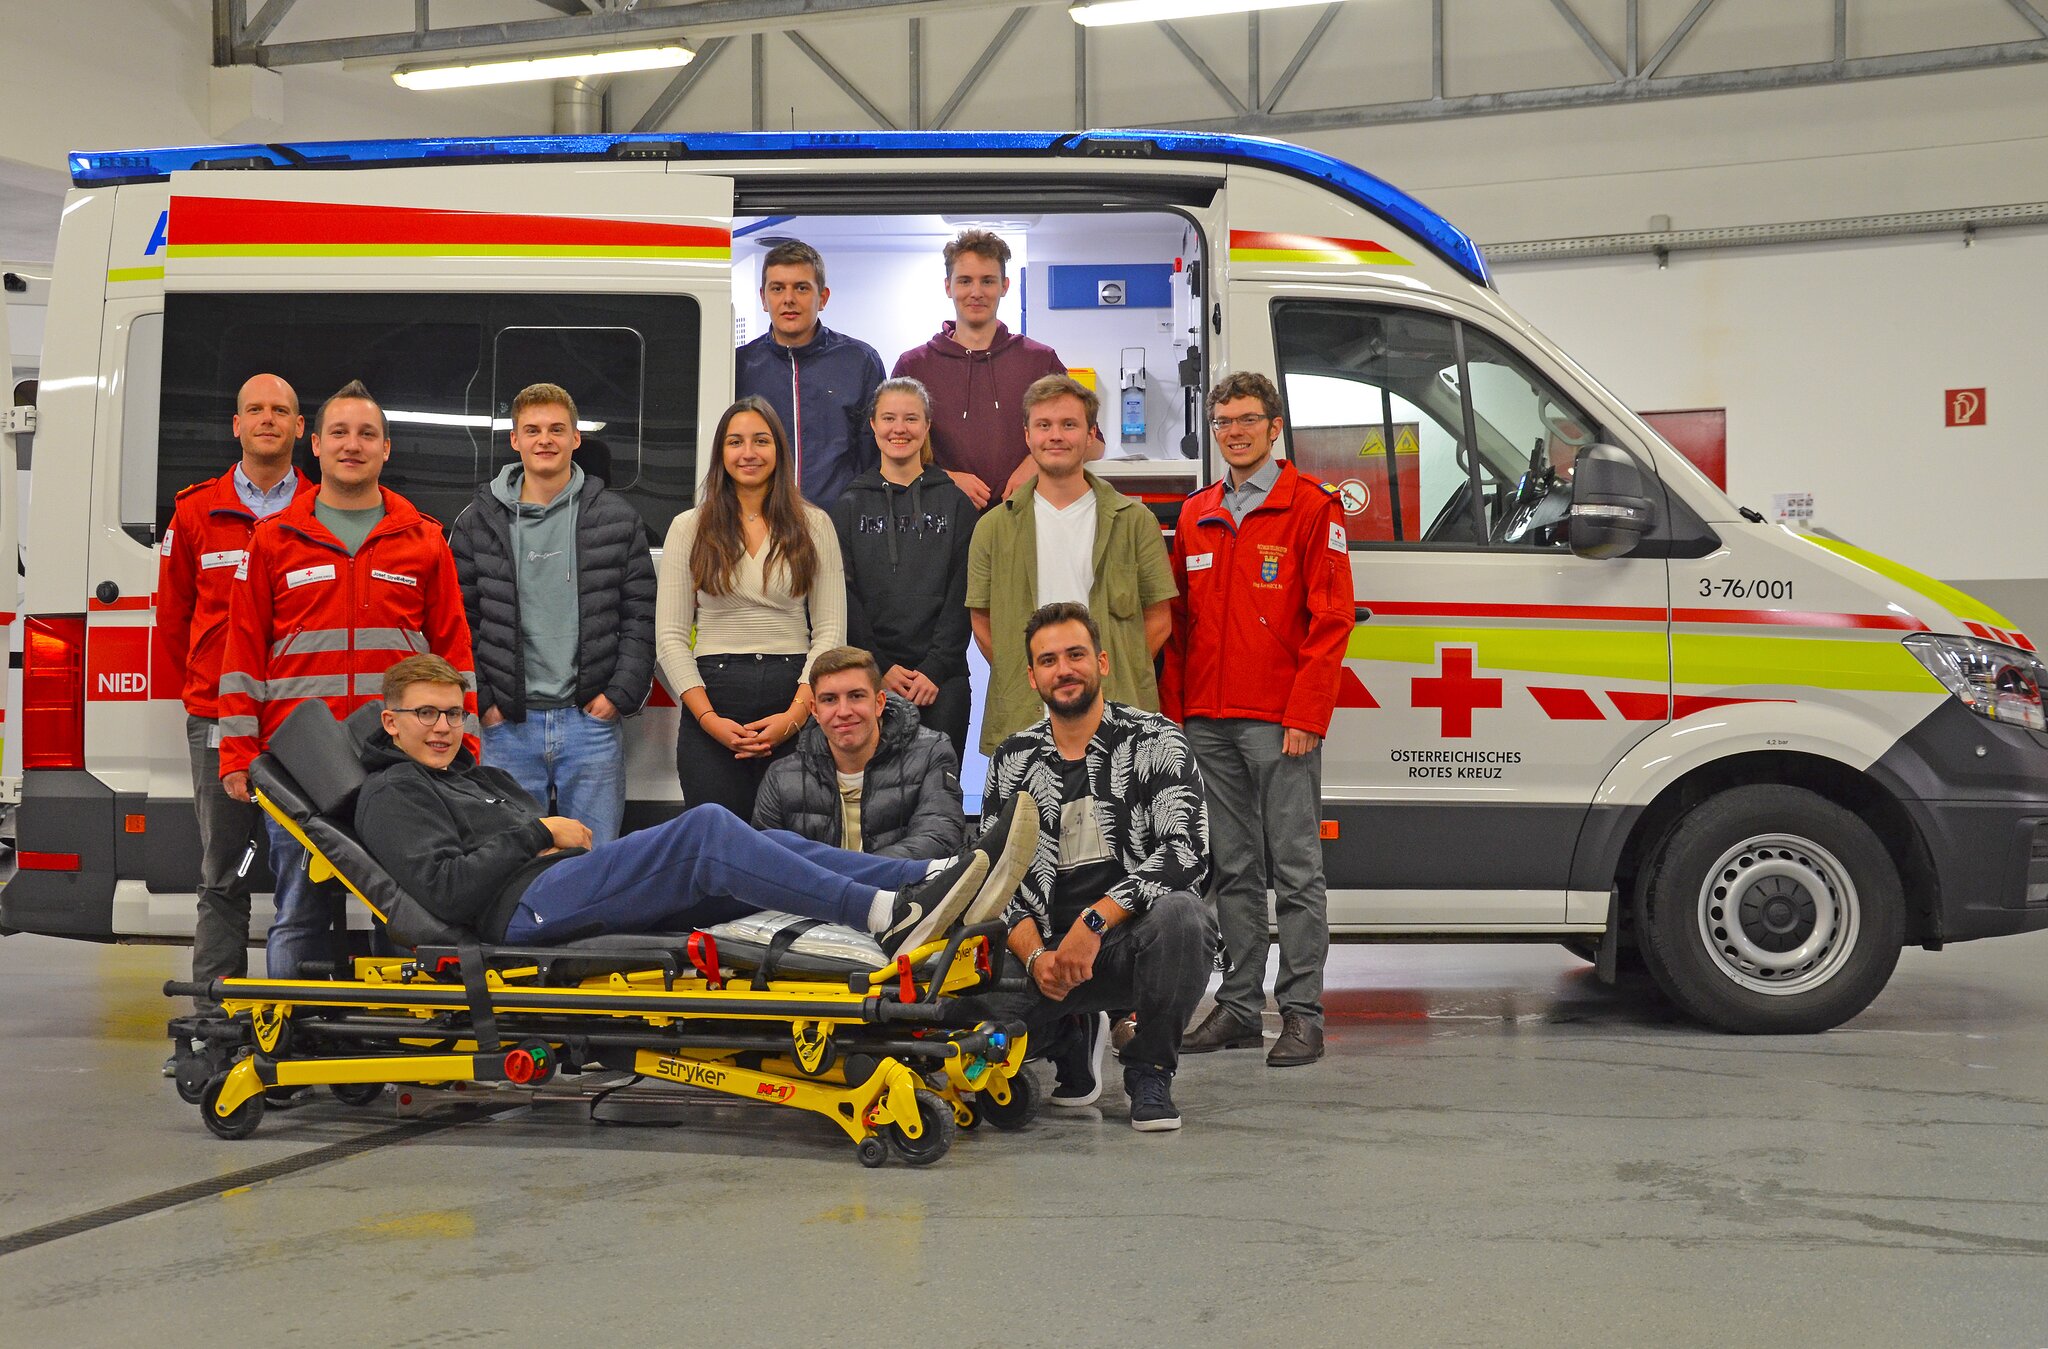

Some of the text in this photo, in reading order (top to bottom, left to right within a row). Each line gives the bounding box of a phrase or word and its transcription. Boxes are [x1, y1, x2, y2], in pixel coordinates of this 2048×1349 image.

[1699, 578, 1792, 600] 3-76/001
[98, 672, 147, 693] NIED
[1390, 749, 1522, 764] ÖSTERREICHISCHES
[1408, 766, 1502, 779] ROTES KREUZ
[656, 1056, 727, 1086] stryker
